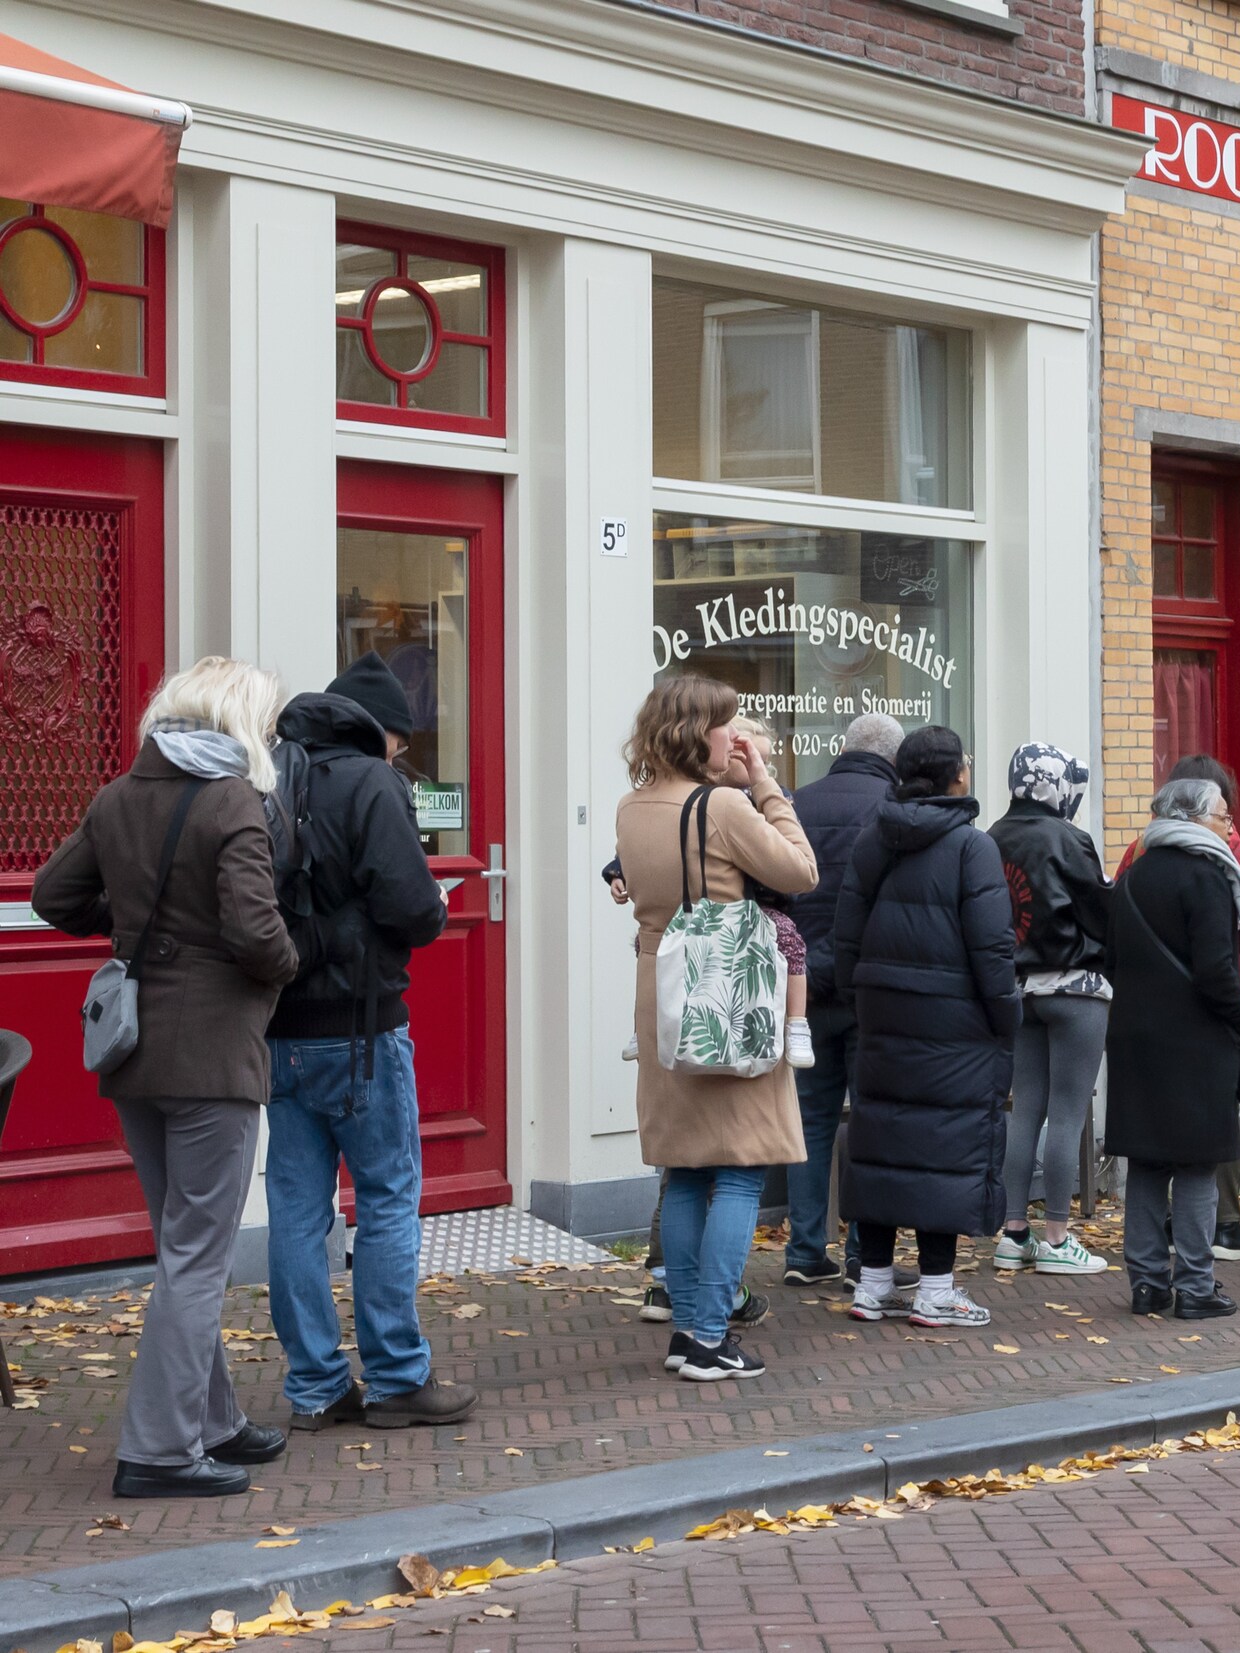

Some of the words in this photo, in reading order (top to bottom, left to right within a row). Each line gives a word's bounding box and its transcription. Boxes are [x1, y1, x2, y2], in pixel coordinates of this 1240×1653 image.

[653, 625, 691, 674] De
[695, 587, 957, 689] Kledingspecialist
[833, 696, 855, 714] en
[861, 688, 932, 723] Stomerij
